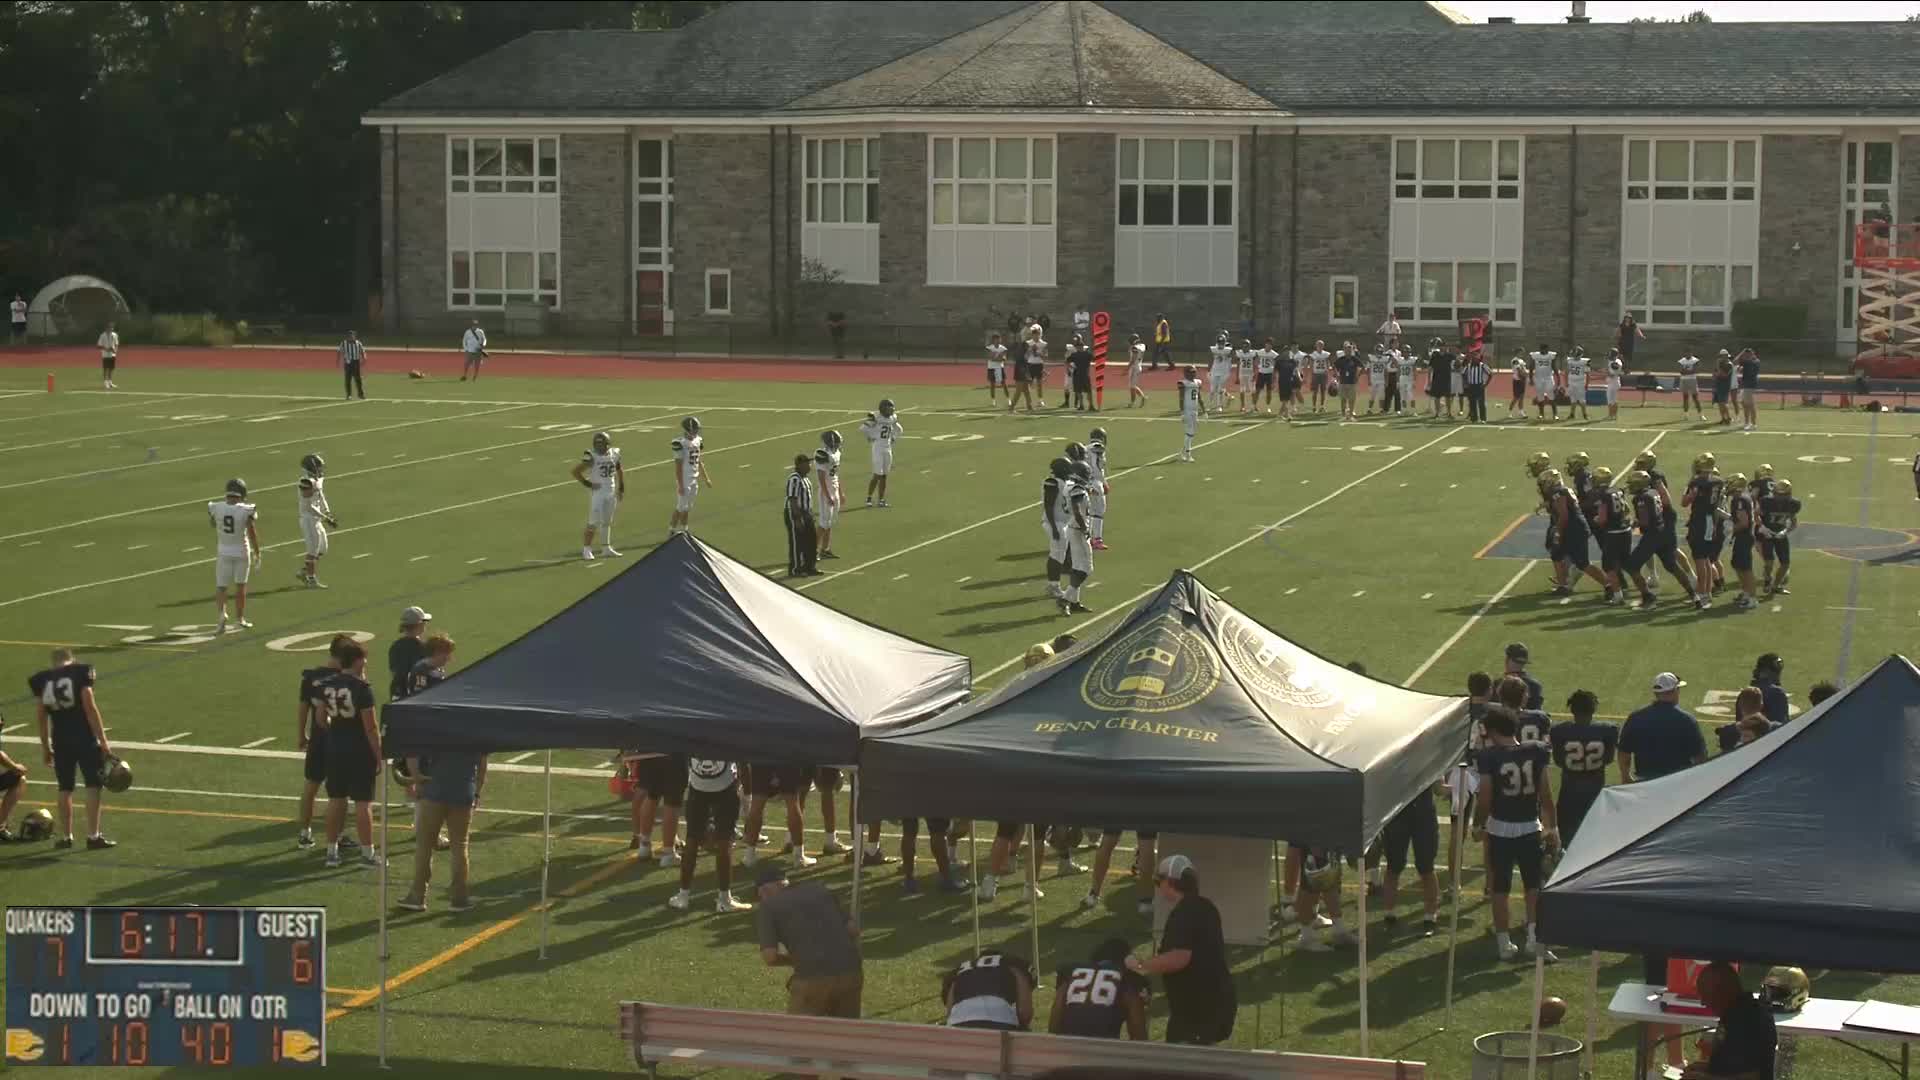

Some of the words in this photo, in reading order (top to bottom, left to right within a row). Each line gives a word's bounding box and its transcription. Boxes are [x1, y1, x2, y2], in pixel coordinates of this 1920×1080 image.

[223, 515, 235, 535] 9
[43, 677, 75, 711] 43
[324, 687, 356, 718] 33
[1033, 720, 1101, 733] PENN
[1105, 717, 1219, 743] CHARTER
[1564, 741, 1606, 771] 22
[1500, 760, 1536, 797] 31
[1066, 967, 1121, 1006] 26
